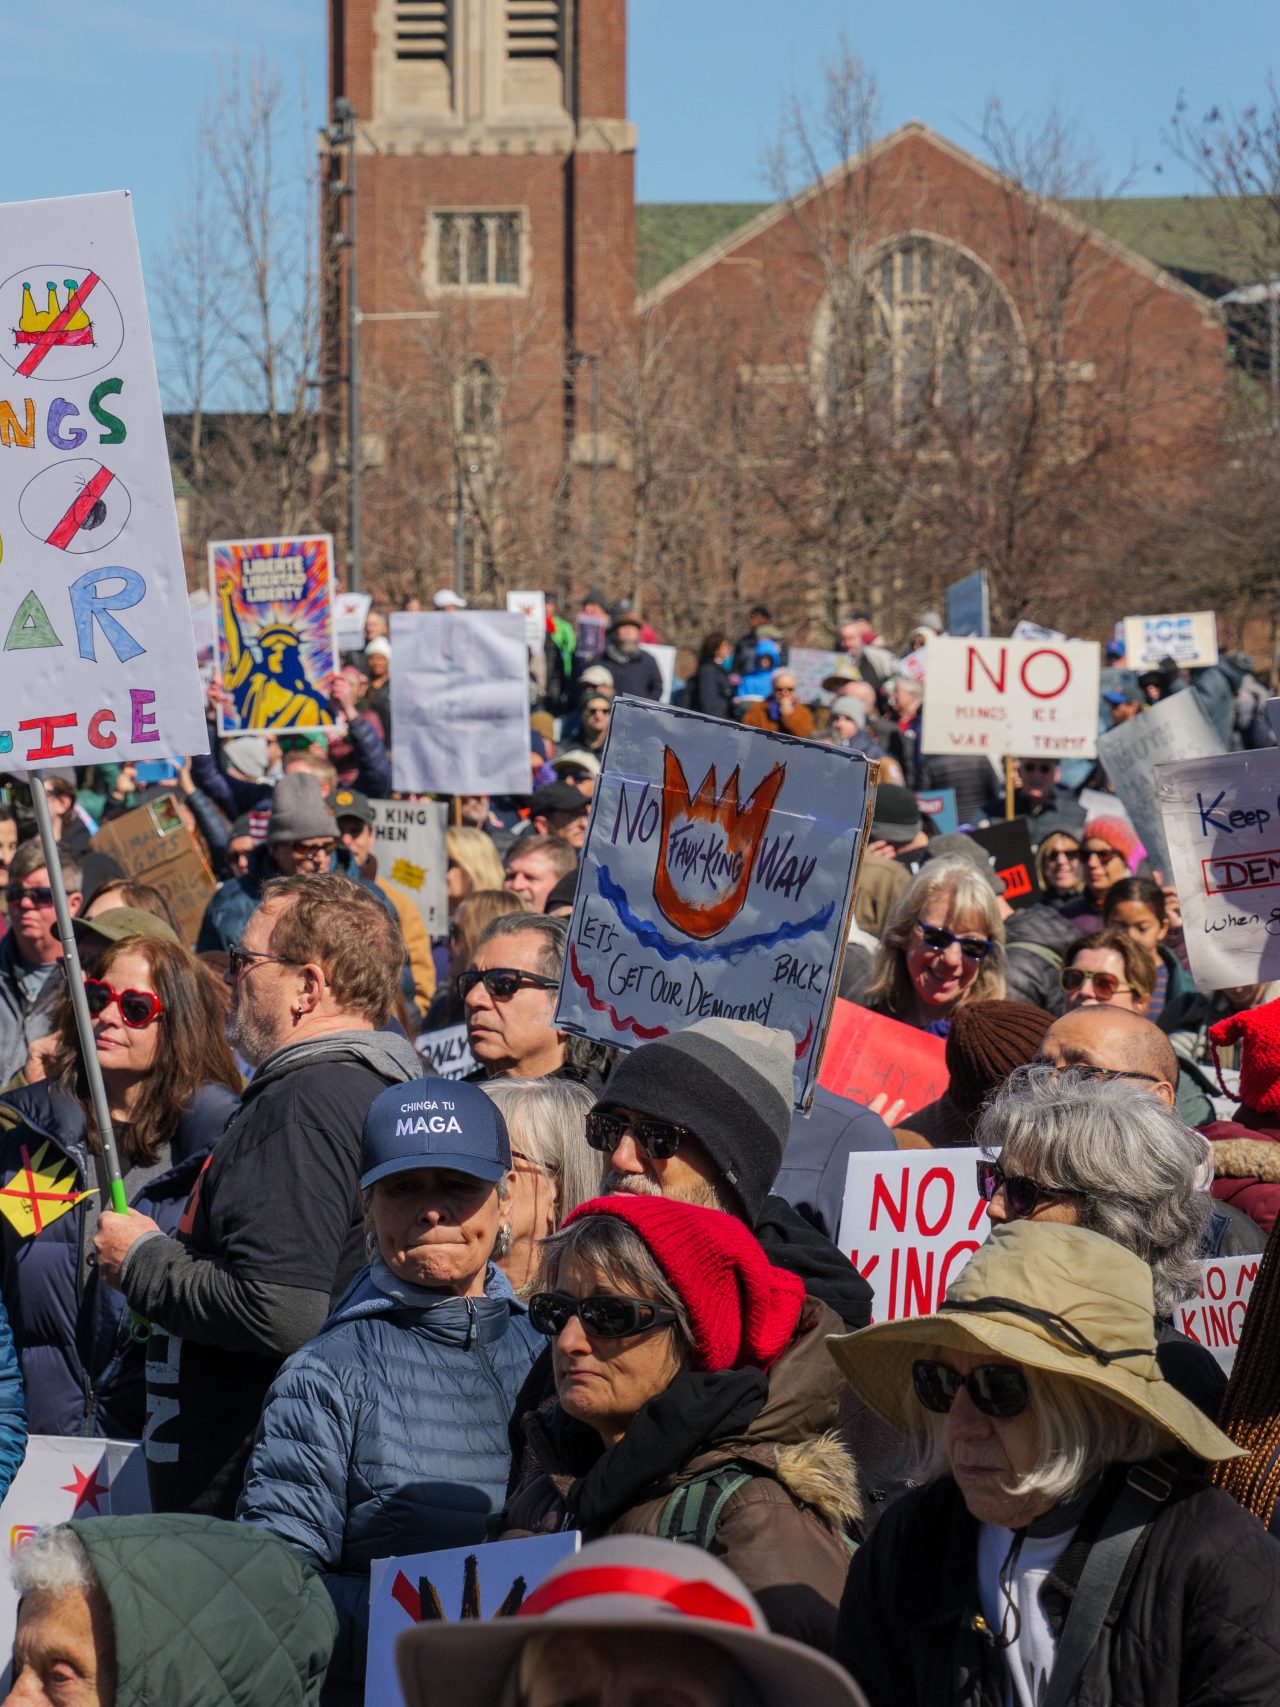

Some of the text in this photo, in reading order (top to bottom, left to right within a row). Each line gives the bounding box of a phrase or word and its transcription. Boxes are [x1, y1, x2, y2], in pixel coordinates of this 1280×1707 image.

[966, 646, 1071, 700] NO
[1032, 707, 1058, 722] ICE
[948, 731, 1087, 751] WAR TRUMP
[385, 808, 427, 825] KING
[1197, 791, 1269, 836] Keep
[376, 826, 408, 841] HEN
[608, 953, 654, 996] GET
[650, 970, 683, 1007] OUR
[771, 954, 823, 993] BACK
[400, 1100, 455, 1113] CHINGA TU
[395, 1115, 463, 1137] MAGA
[869, 1167, 956, 1237] NO
